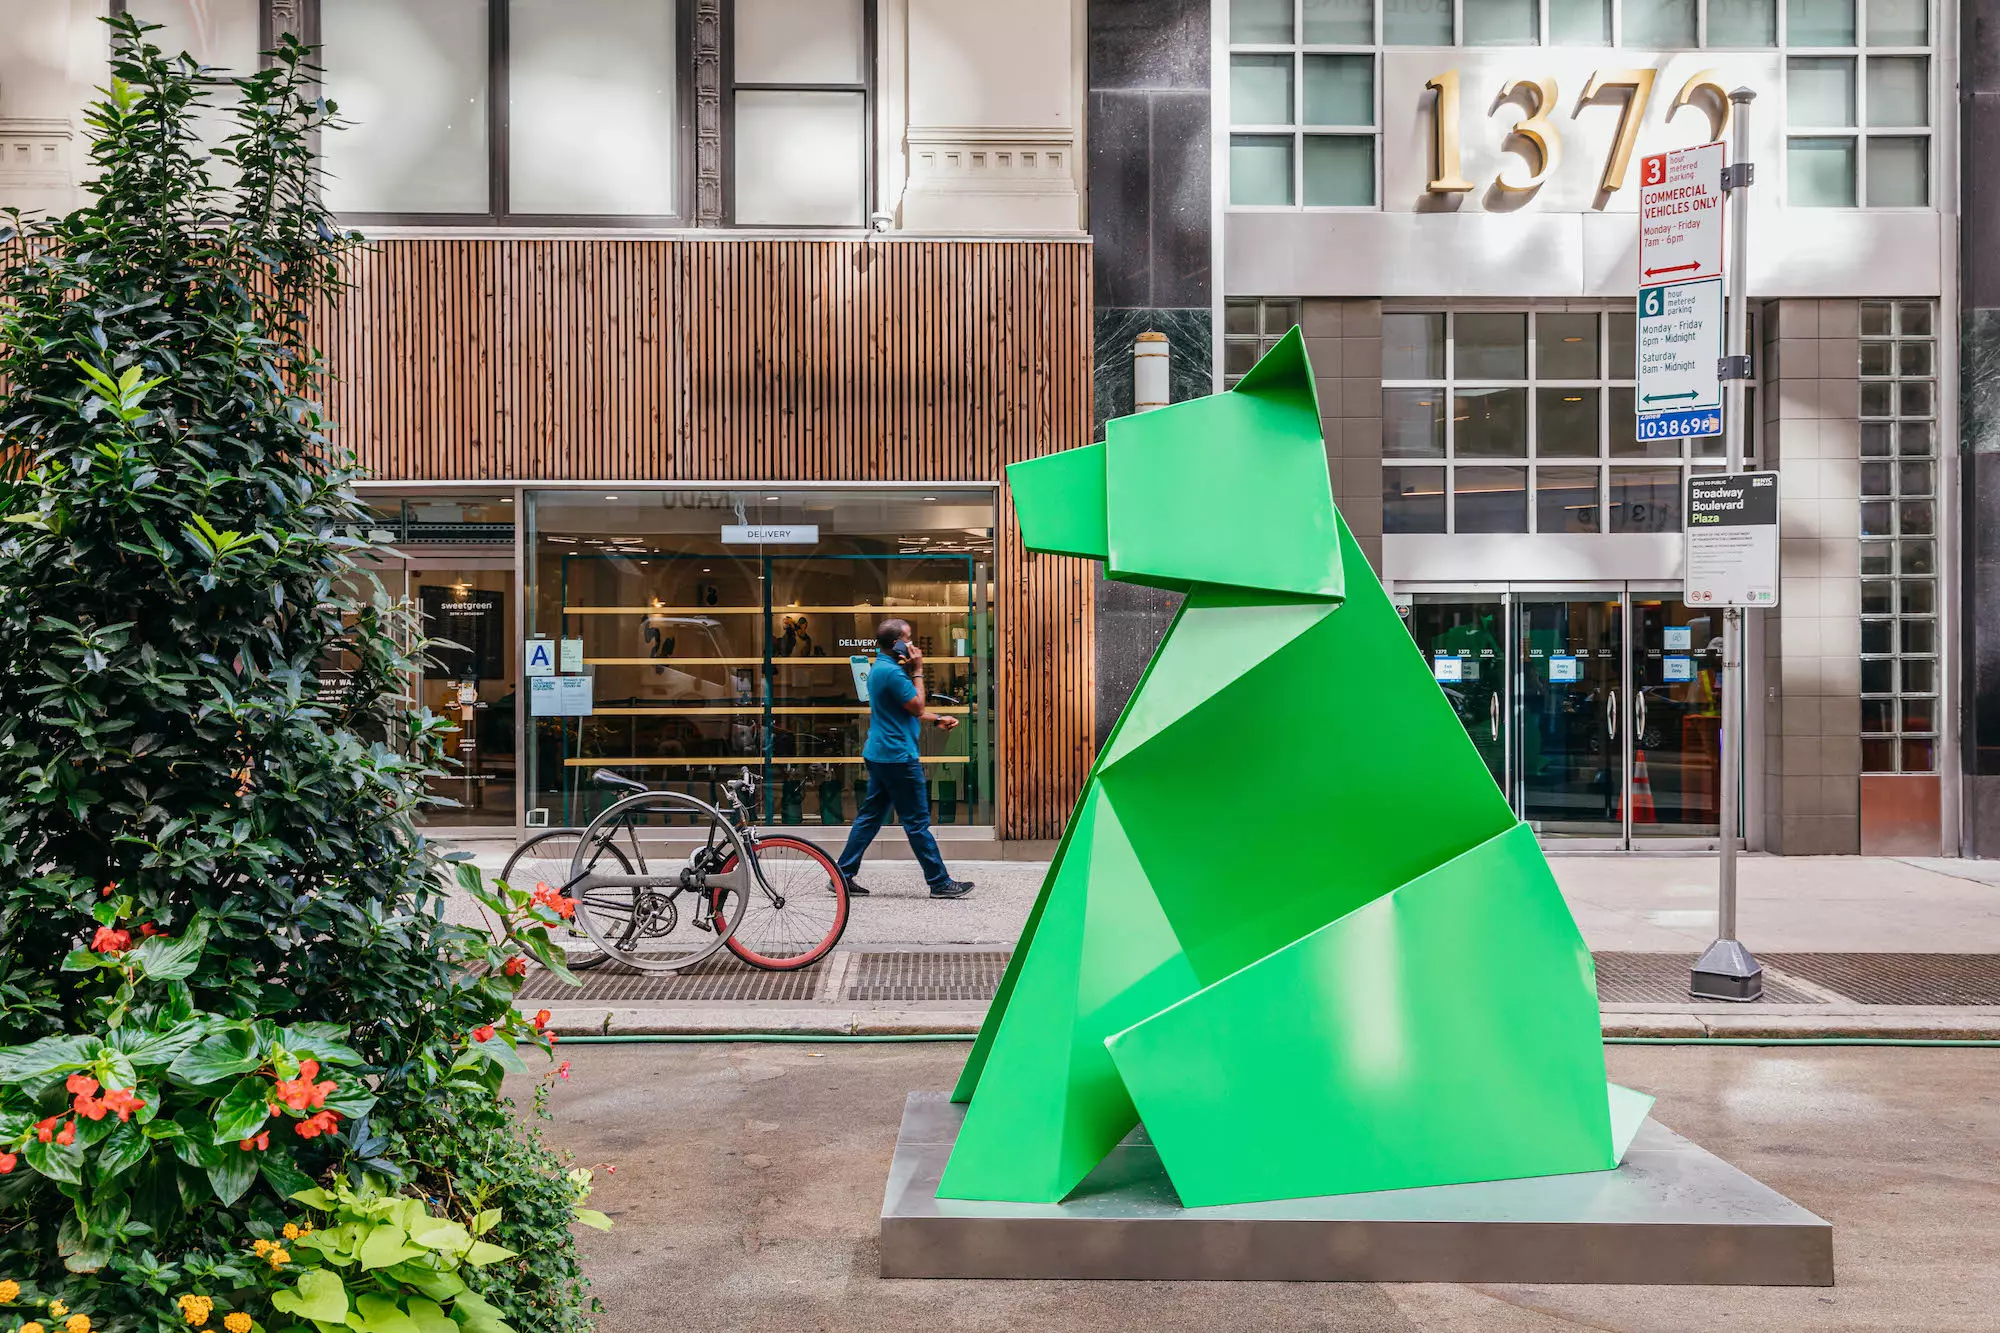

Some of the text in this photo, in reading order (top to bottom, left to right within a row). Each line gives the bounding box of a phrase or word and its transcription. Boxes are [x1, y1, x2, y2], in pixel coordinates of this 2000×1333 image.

[1670, 155, 1685, 164] hour
[1647, 159, 1661, 184] 3
[1669, 161, 1698, 173] metered
[1669, 171, 1695, 183] parking
[1645, 184, 1707, 205] COMMERCIAL
[1645, 196, 1718, 219] VEHICLES ONLY
[1643, 224, 1671, 236] Monday
[1678, 220, 1701, 230] Friday
[1643, 237, 1659, 247] 7am
[1666, 234, 1684, 245] 6pm
[1645, 290, 1659, 315] 6
[1667, 297, 1696, 306] metered
[1667, 306, 1692, 316] parking
[1642, 324, 1671, 334] Monday
[1679, 320, 1703, 331] Friday
[1642, 337, 1658, 347] 6pm
[1665, 332, 1696, 343] Midnight
[1642, 352, 1676, 362] Saturday
[1642, 365, 1658, 374] 8am
[1665, 361, 1696, 372] Midnight
[1640, 418, 1700, 438] 103869
[1692, 487, 1743, 499] Broadway
[1692, 499, 1744, 511] Boulevard
[1692, 513, 1720, 523] Plaza
[748, 530, 791, 538] DELIVERY
[441, 602, 492, 610] sweetgreen
[531, 645, 549, 666] A
